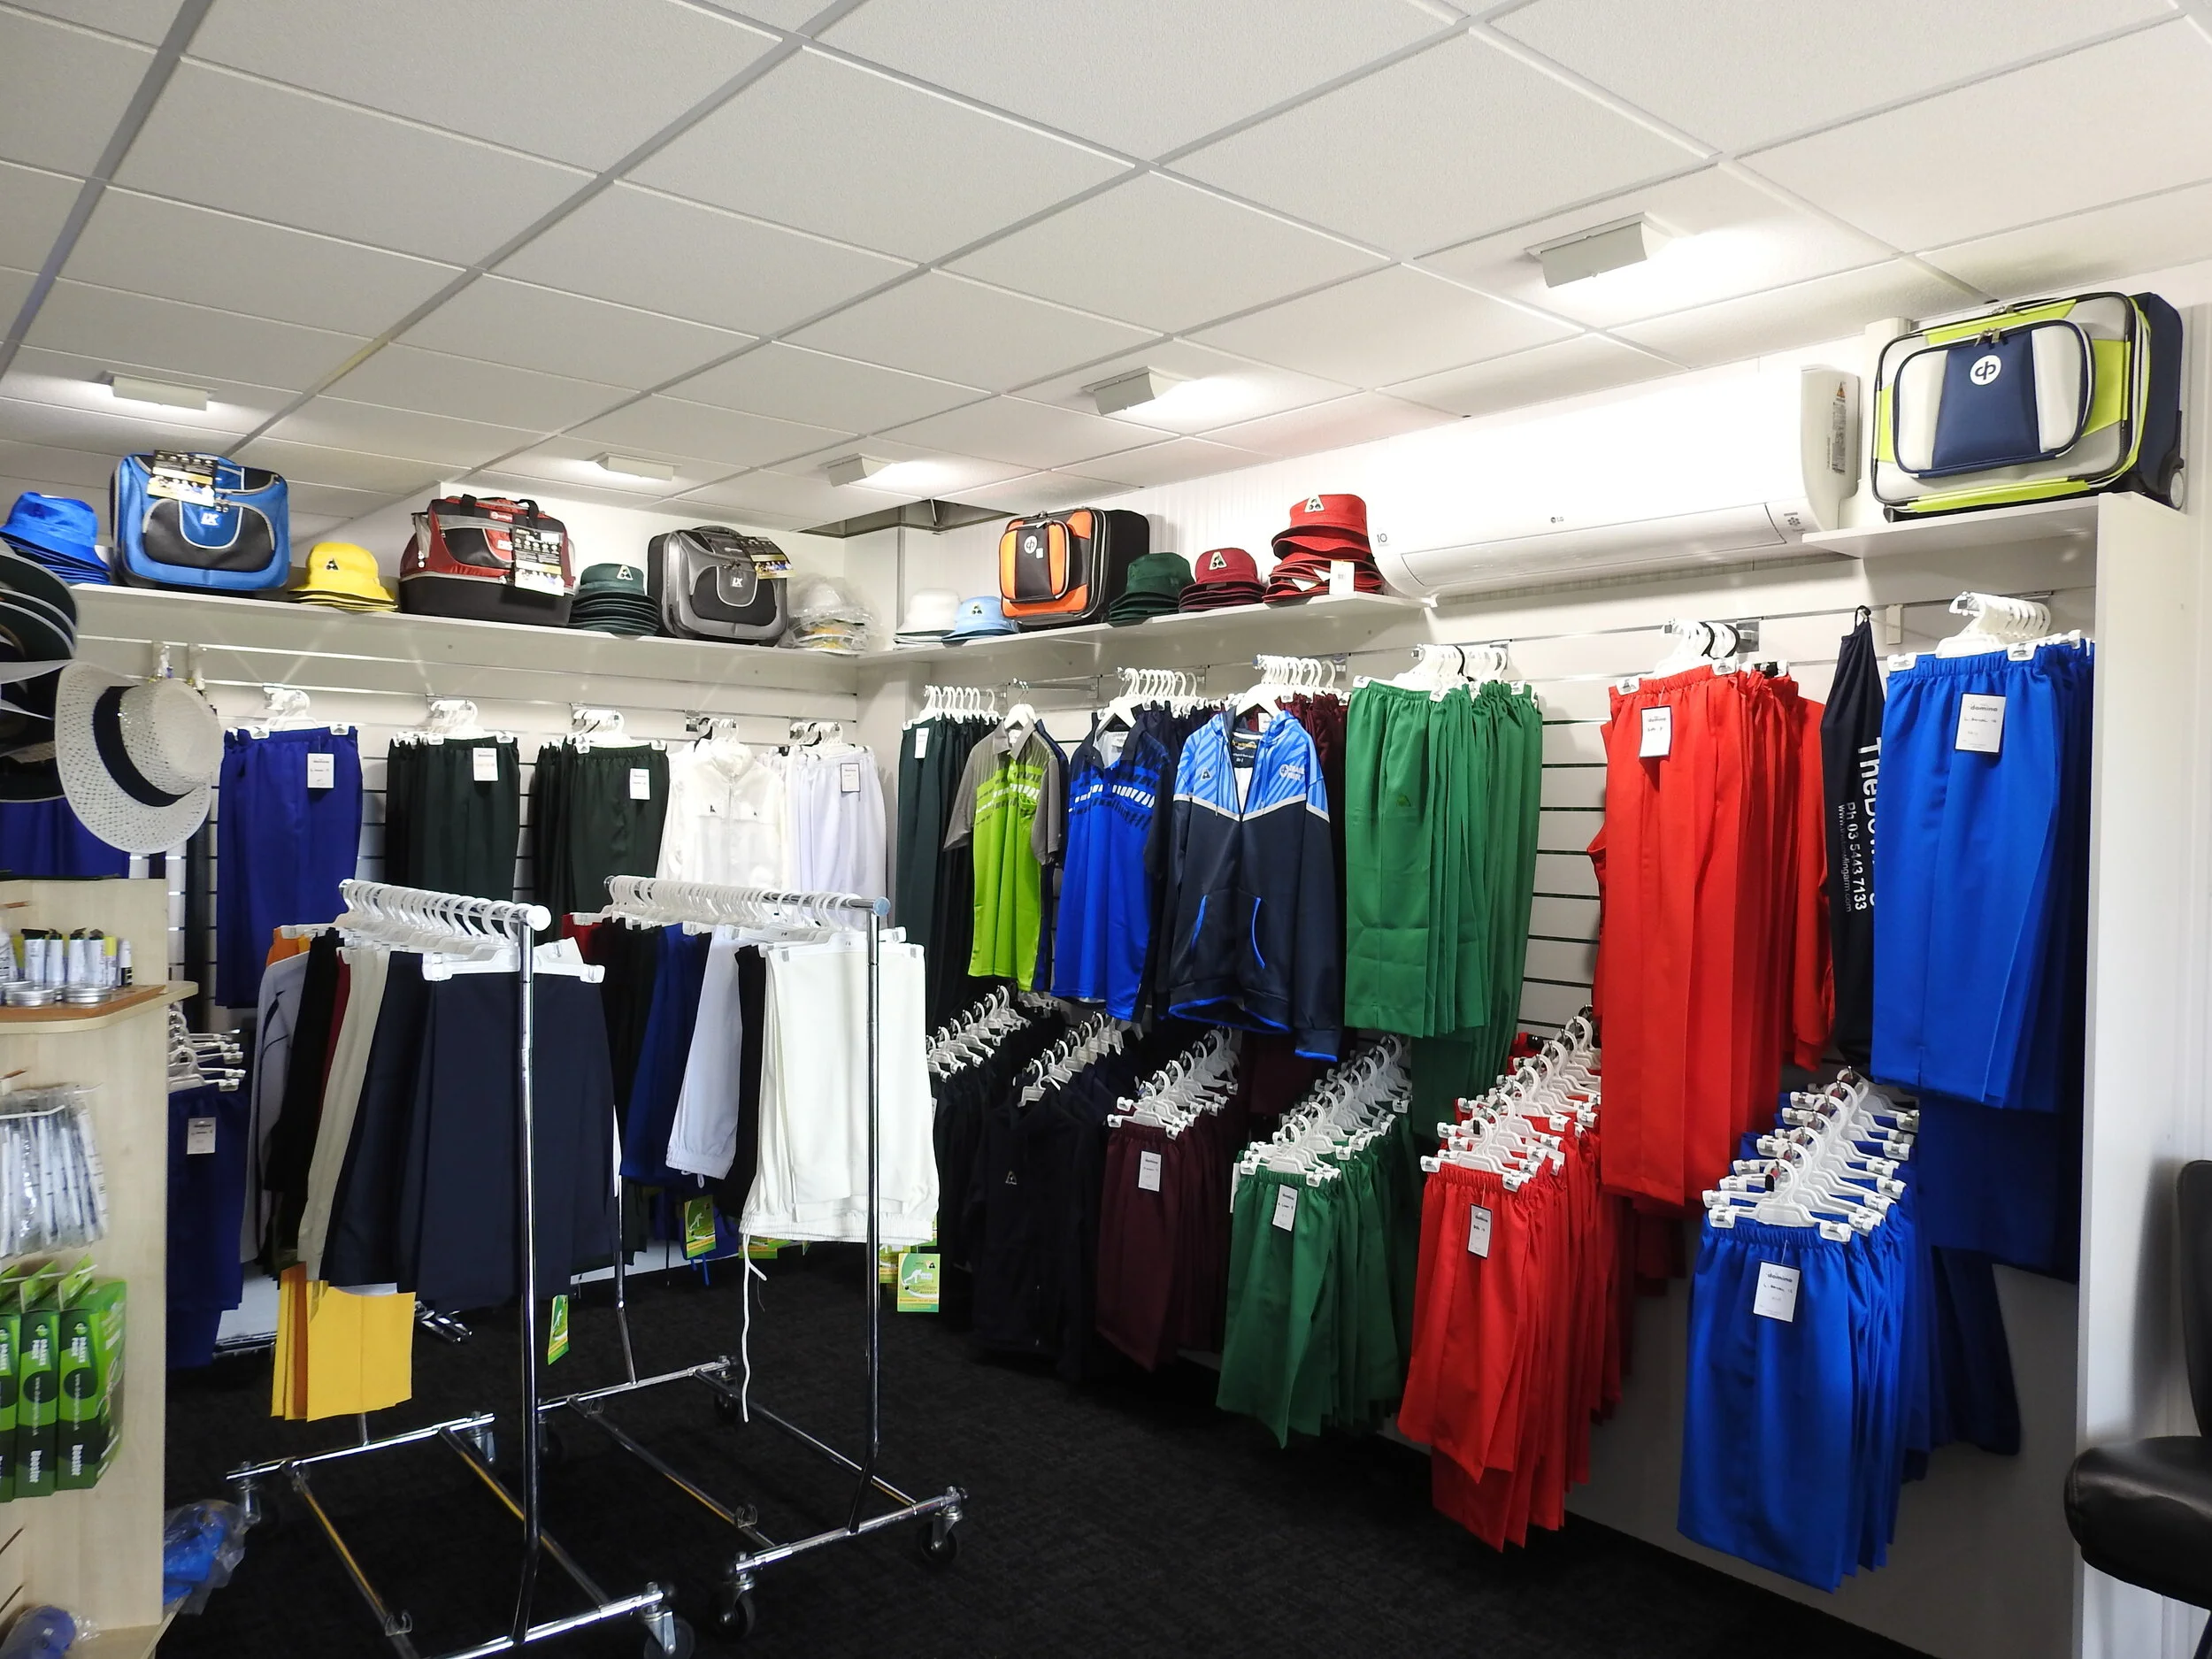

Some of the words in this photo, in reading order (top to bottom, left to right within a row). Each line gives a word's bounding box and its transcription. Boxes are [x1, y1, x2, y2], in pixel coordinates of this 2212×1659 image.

[1846, 802, 1857, 819] Ph
[1847, 823, 1859, 840] 03
[1849, 843, 1863, 875] 5443
[1852, 877, 1868, 910] 7133
[29, 1450, 42, 1483] Booster
[71, 1444, 84, 1477] Booster
